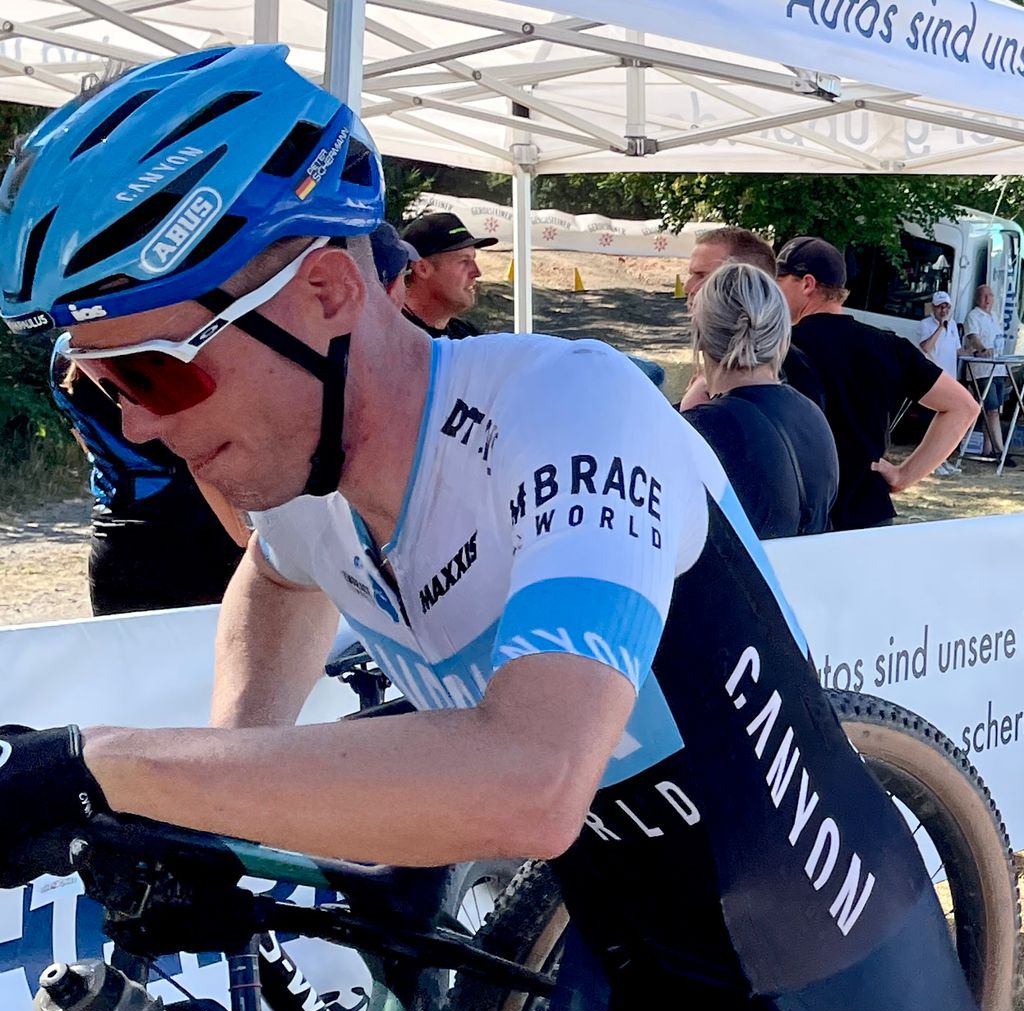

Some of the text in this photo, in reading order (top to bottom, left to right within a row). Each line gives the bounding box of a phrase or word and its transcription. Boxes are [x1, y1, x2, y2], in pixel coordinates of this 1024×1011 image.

[786, 0, 899, 44] Autos
[906, 0, 977, 64] sind
[115, 146, 204, 202] CANYON
[306, 148, 328, 177] PETER
[152, 196, 214, 263] ABUS
[440, 398, 486, 446] DT
[534, 503, 662, 551] WORLD
[419, 529, 479, 615] MAXXIS
[873, 623, 929, 688] sind
[937, 627, 1017, 673] unsere
[724, 645, 877, 938] CANYON
